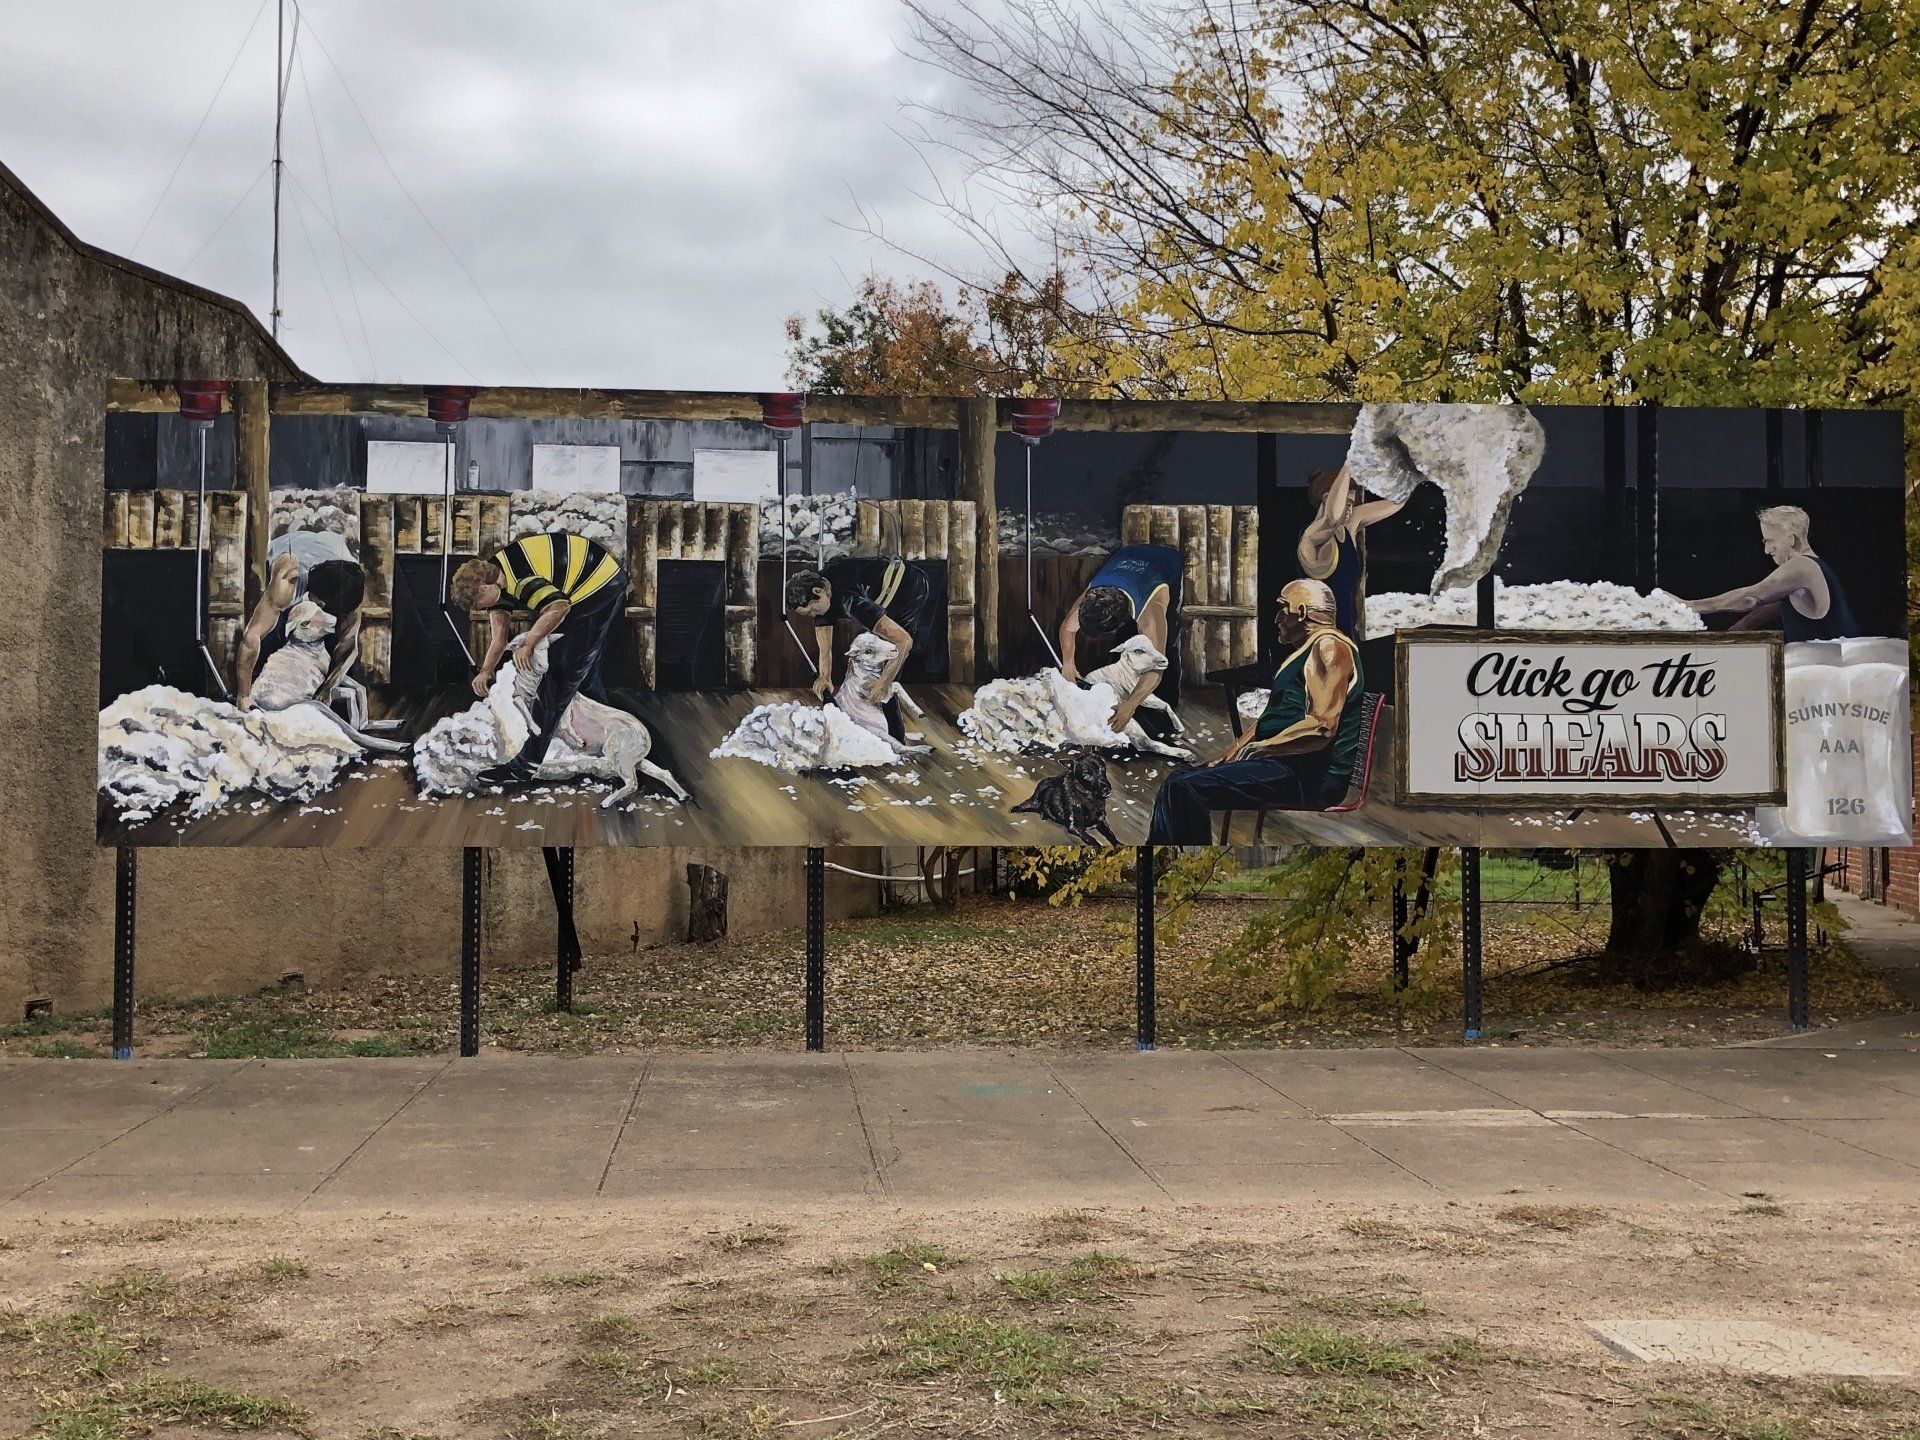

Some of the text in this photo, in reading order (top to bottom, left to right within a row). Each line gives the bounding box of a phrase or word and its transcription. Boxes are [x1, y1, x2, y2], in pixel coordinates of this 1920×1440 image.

[1467, 652, 1719, 713] Click go the
[1788, 703, 1890, 725] SUNNYSIDE
[1454, 712, 1728, 782] SHEARS
[1820, 739, 1860, 753] AAA
[1827, 798, 1866, 816] 126
